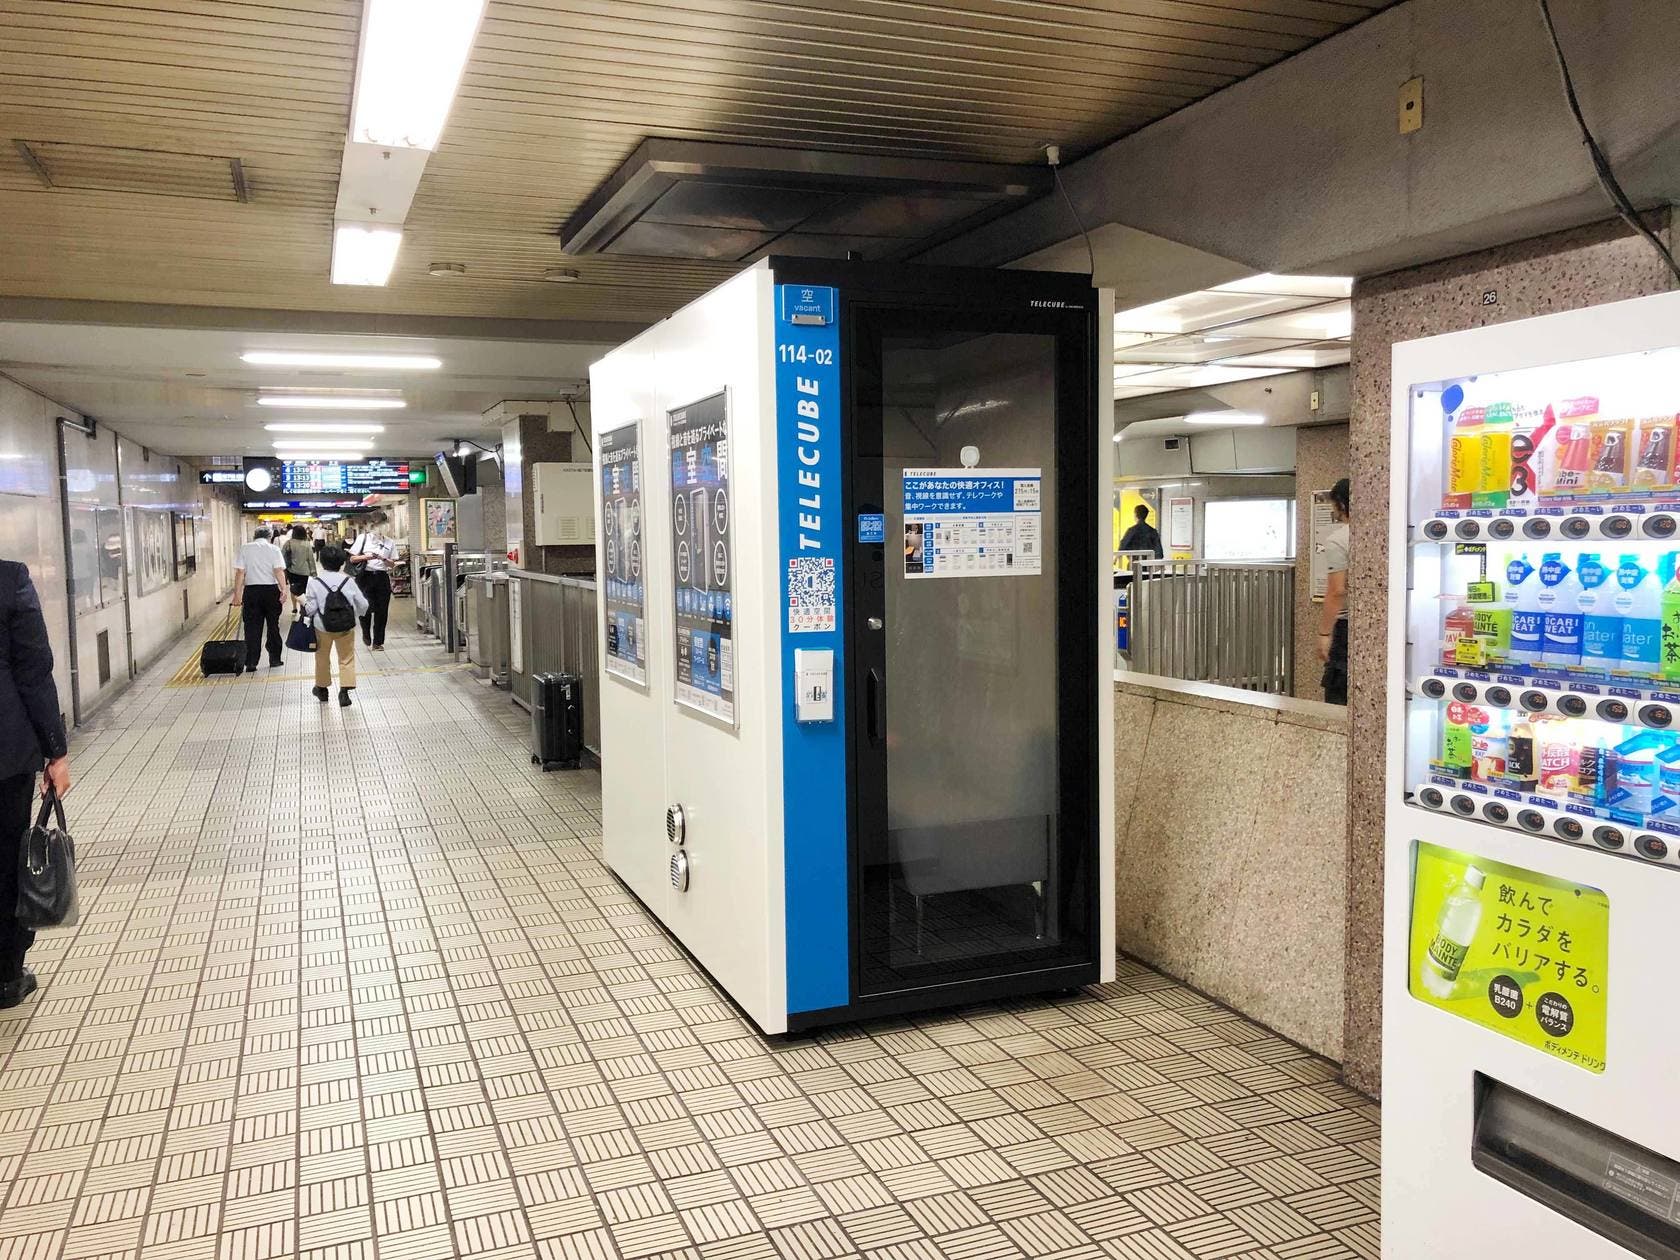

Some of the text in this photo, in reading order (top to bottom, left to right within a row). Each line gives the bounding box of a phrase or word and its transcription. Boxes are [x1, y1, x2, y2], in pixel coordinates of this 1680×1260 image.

[801, 289, 814, 303] 空
[1483, 291, 1497, 304] 26
[793, 303, 821, 313] vacant
[1030, 300, 1065, 308] TELECUBE
[778, 343, 833, 366] 114-02
[797, 376, 821, 550] TELECUBE
[793, 623, 832, 632] クーポン
[1623, 633, 1653, 645] ater
[1541, 756, 1570, 768] ATCH
[1499, 883, 1553, 916] 飲んで
[1496, 913, 1573, 953] カラダを
[1492, 942, 1600, 993] バリアする。
[1494, 983, 1519, 1001] 乳酸菌
[1494, 995, 1516, 1010] B240
[1541, 1004, 1568, 1023] 電解質
[1540, 1017, 1568, 1032] バランス
[1544, 1040, 1606, 1071] ボディメンテ ドリンク
